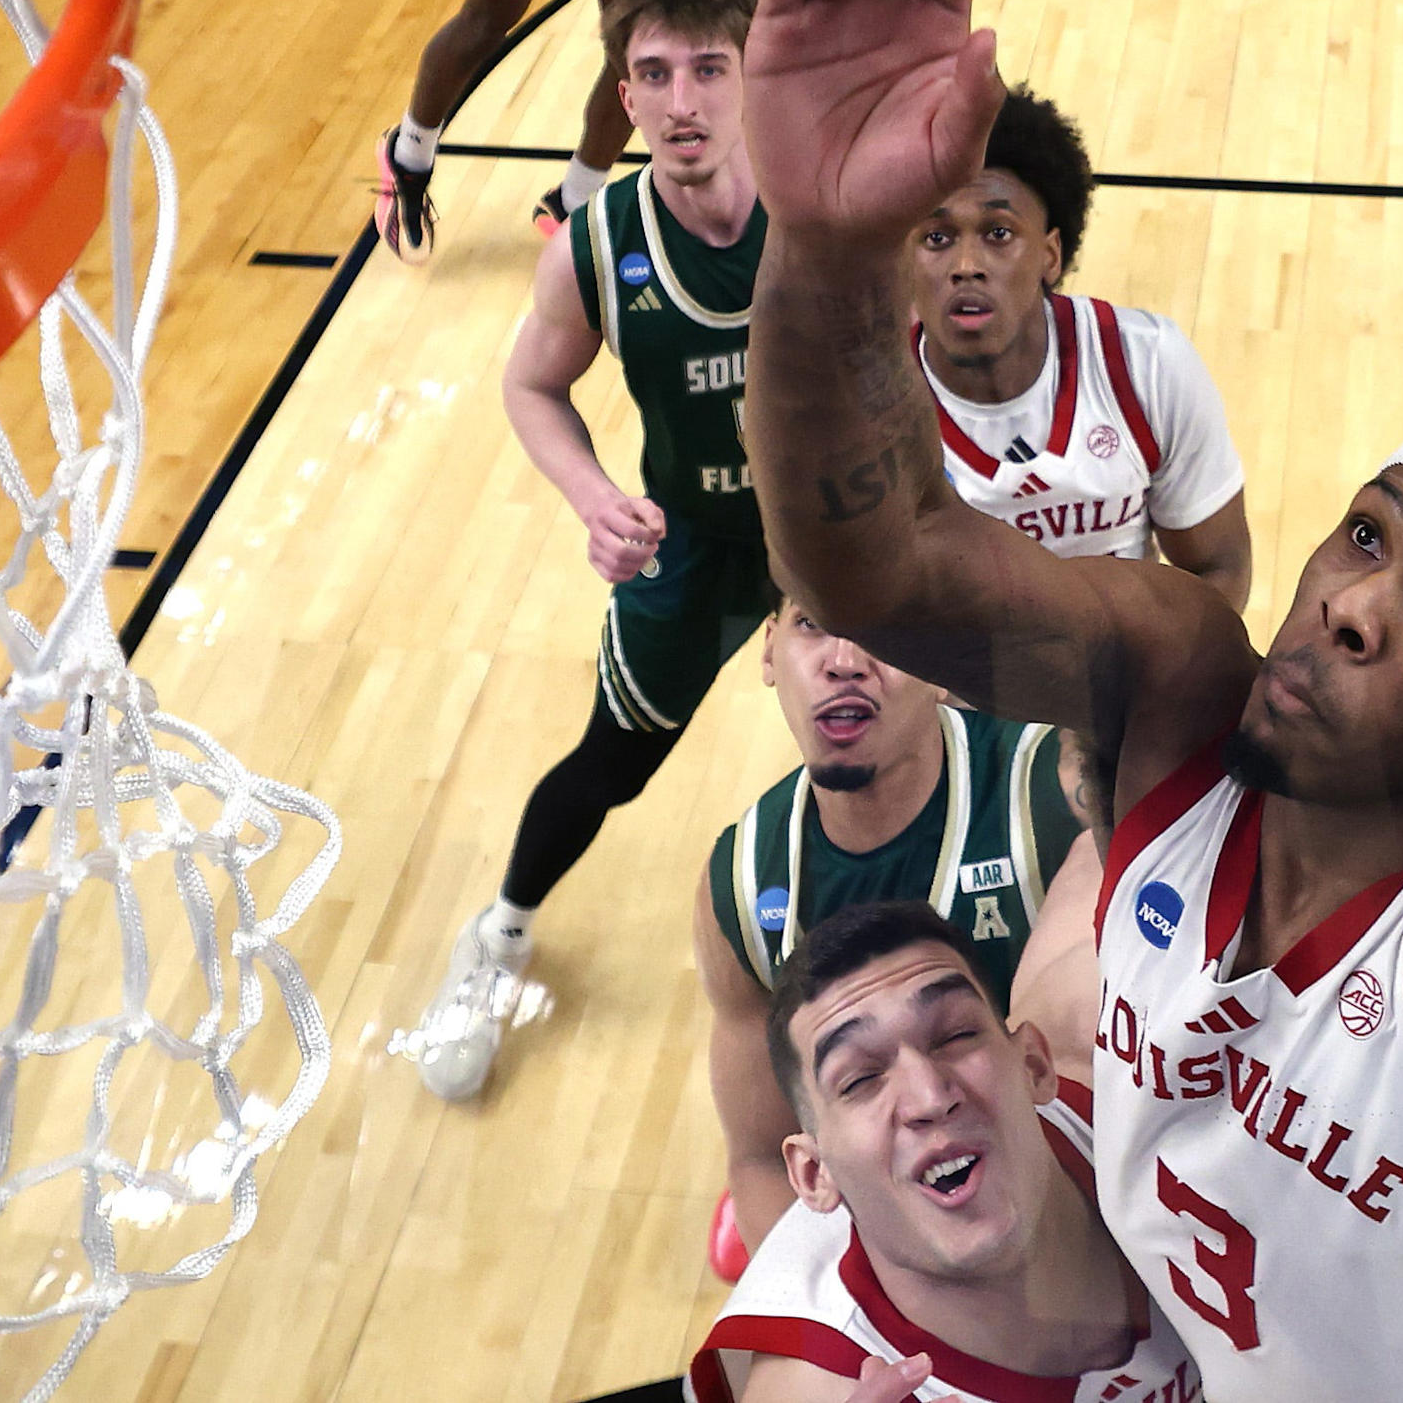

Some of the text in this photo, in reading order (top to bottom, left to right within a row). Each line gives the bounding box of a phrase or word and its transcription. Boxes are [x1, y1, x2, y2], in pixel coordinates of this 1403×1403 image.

[686, 351, 749, 394] SOU
[971, 865, 1004, 889] AAR
[1344, 989, 1385, 1016] ACC
[1156, 1154, 1261, 1352] 3
